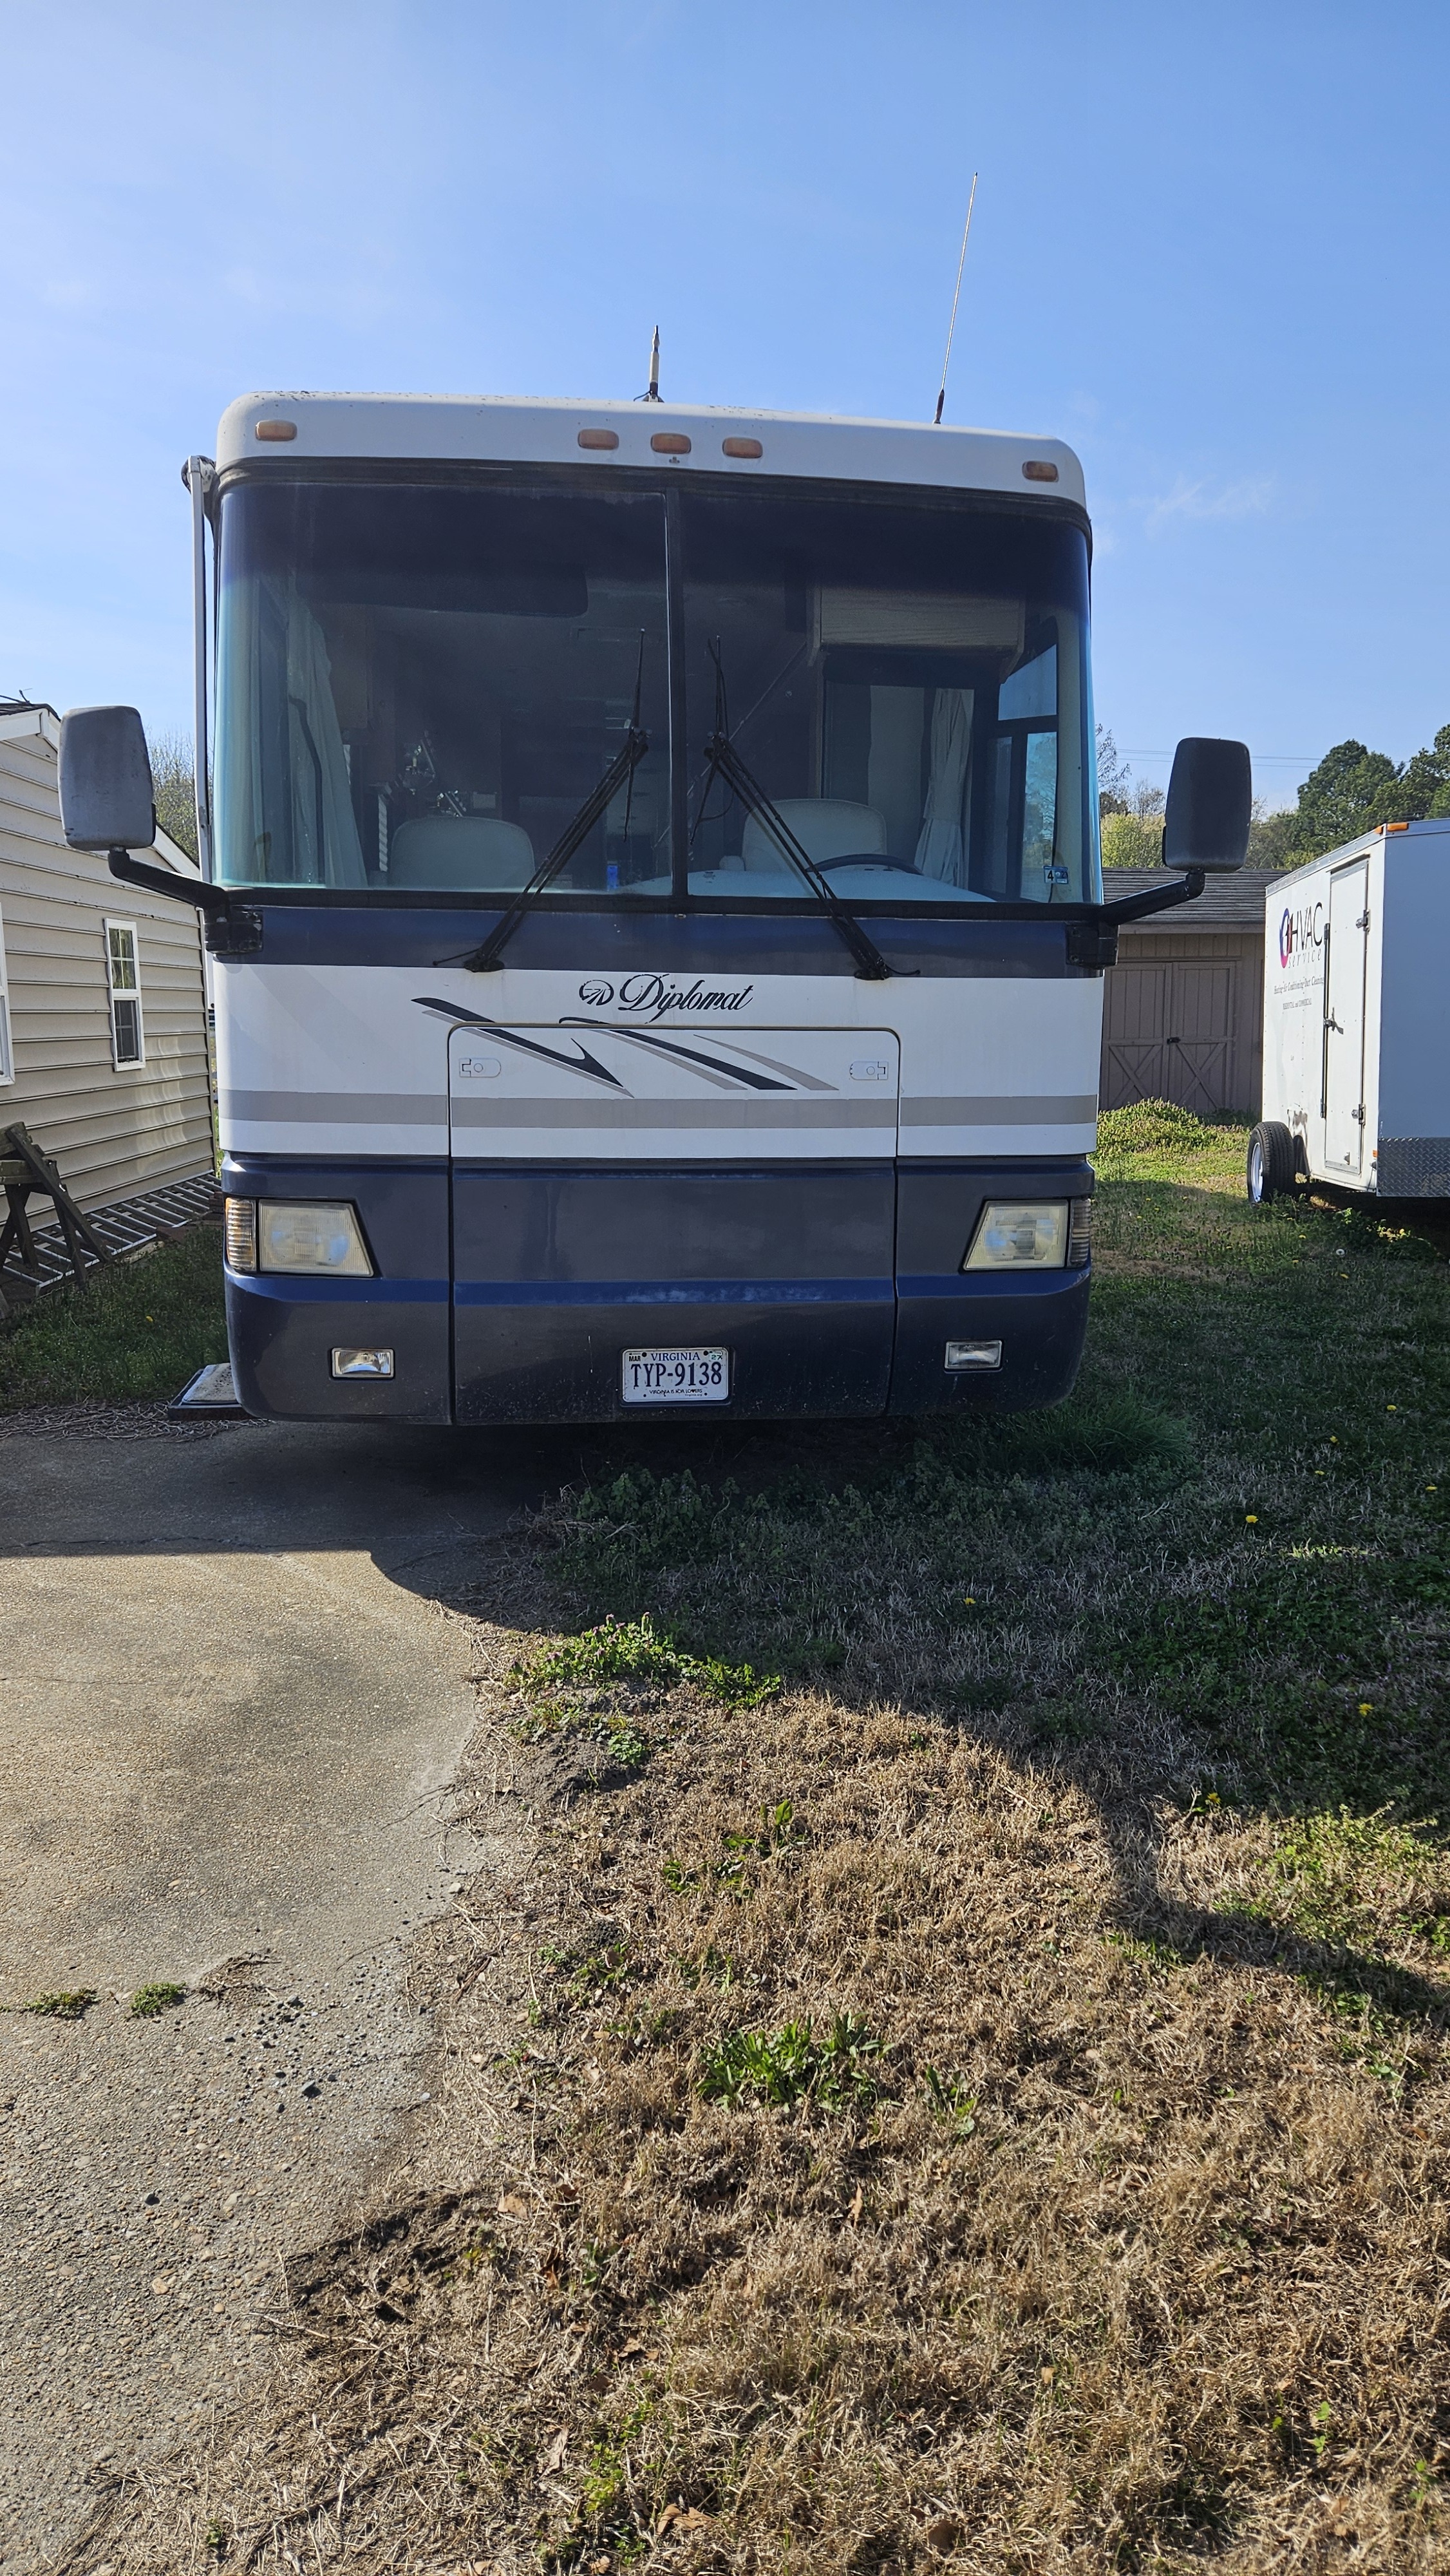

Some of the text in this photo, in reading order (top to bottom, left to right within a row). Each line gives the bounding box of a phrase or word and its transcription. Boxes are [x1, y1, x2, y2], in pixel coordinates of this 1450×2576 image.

[1047, 870, 1054, 881] 4
[1288, 948, 1322, 969] service
[618, 973, 754, 1025] Diplomat
[650, 1352, 701, 1361] VIRGINIA
[630, 1361, 722, 1387] TYP-9138
